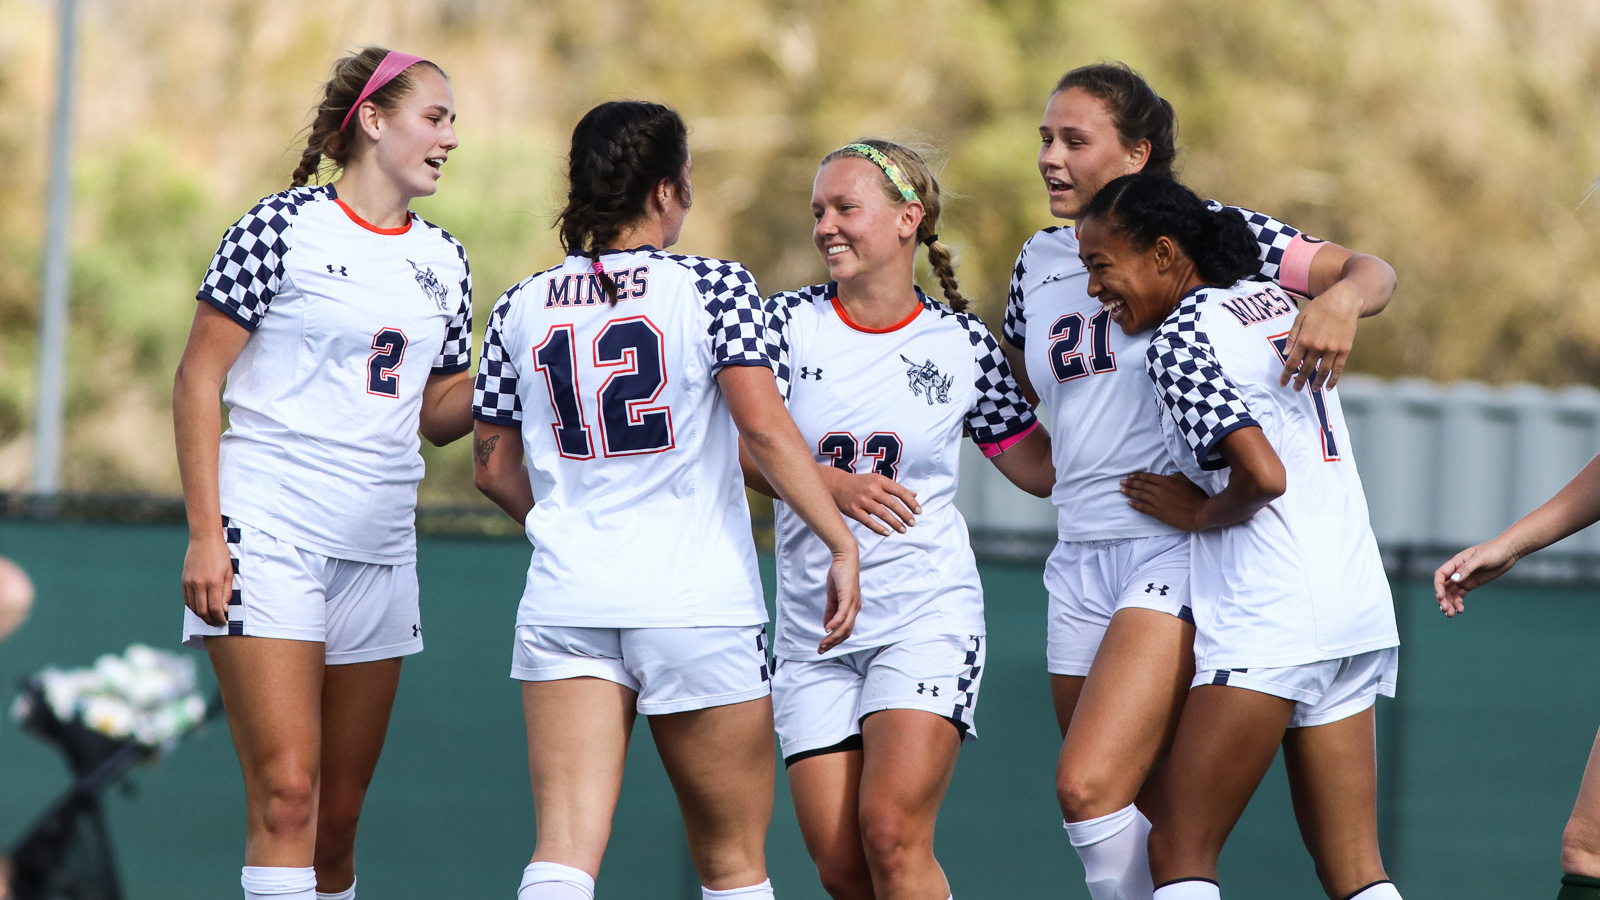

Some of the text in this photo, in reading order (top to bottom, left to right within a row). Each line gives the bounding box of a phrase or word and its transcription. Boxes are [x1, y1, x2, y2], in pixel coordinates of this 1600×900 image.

[543, 264, 650, 309] MINES
[1218, 286, 1293, 328] MINES
[366, 327, 409, 399] 2
[1048, 306, 1117, 384] 21
[532, 315, 675, 461] 12
[818, 431, 903, 482] 33
